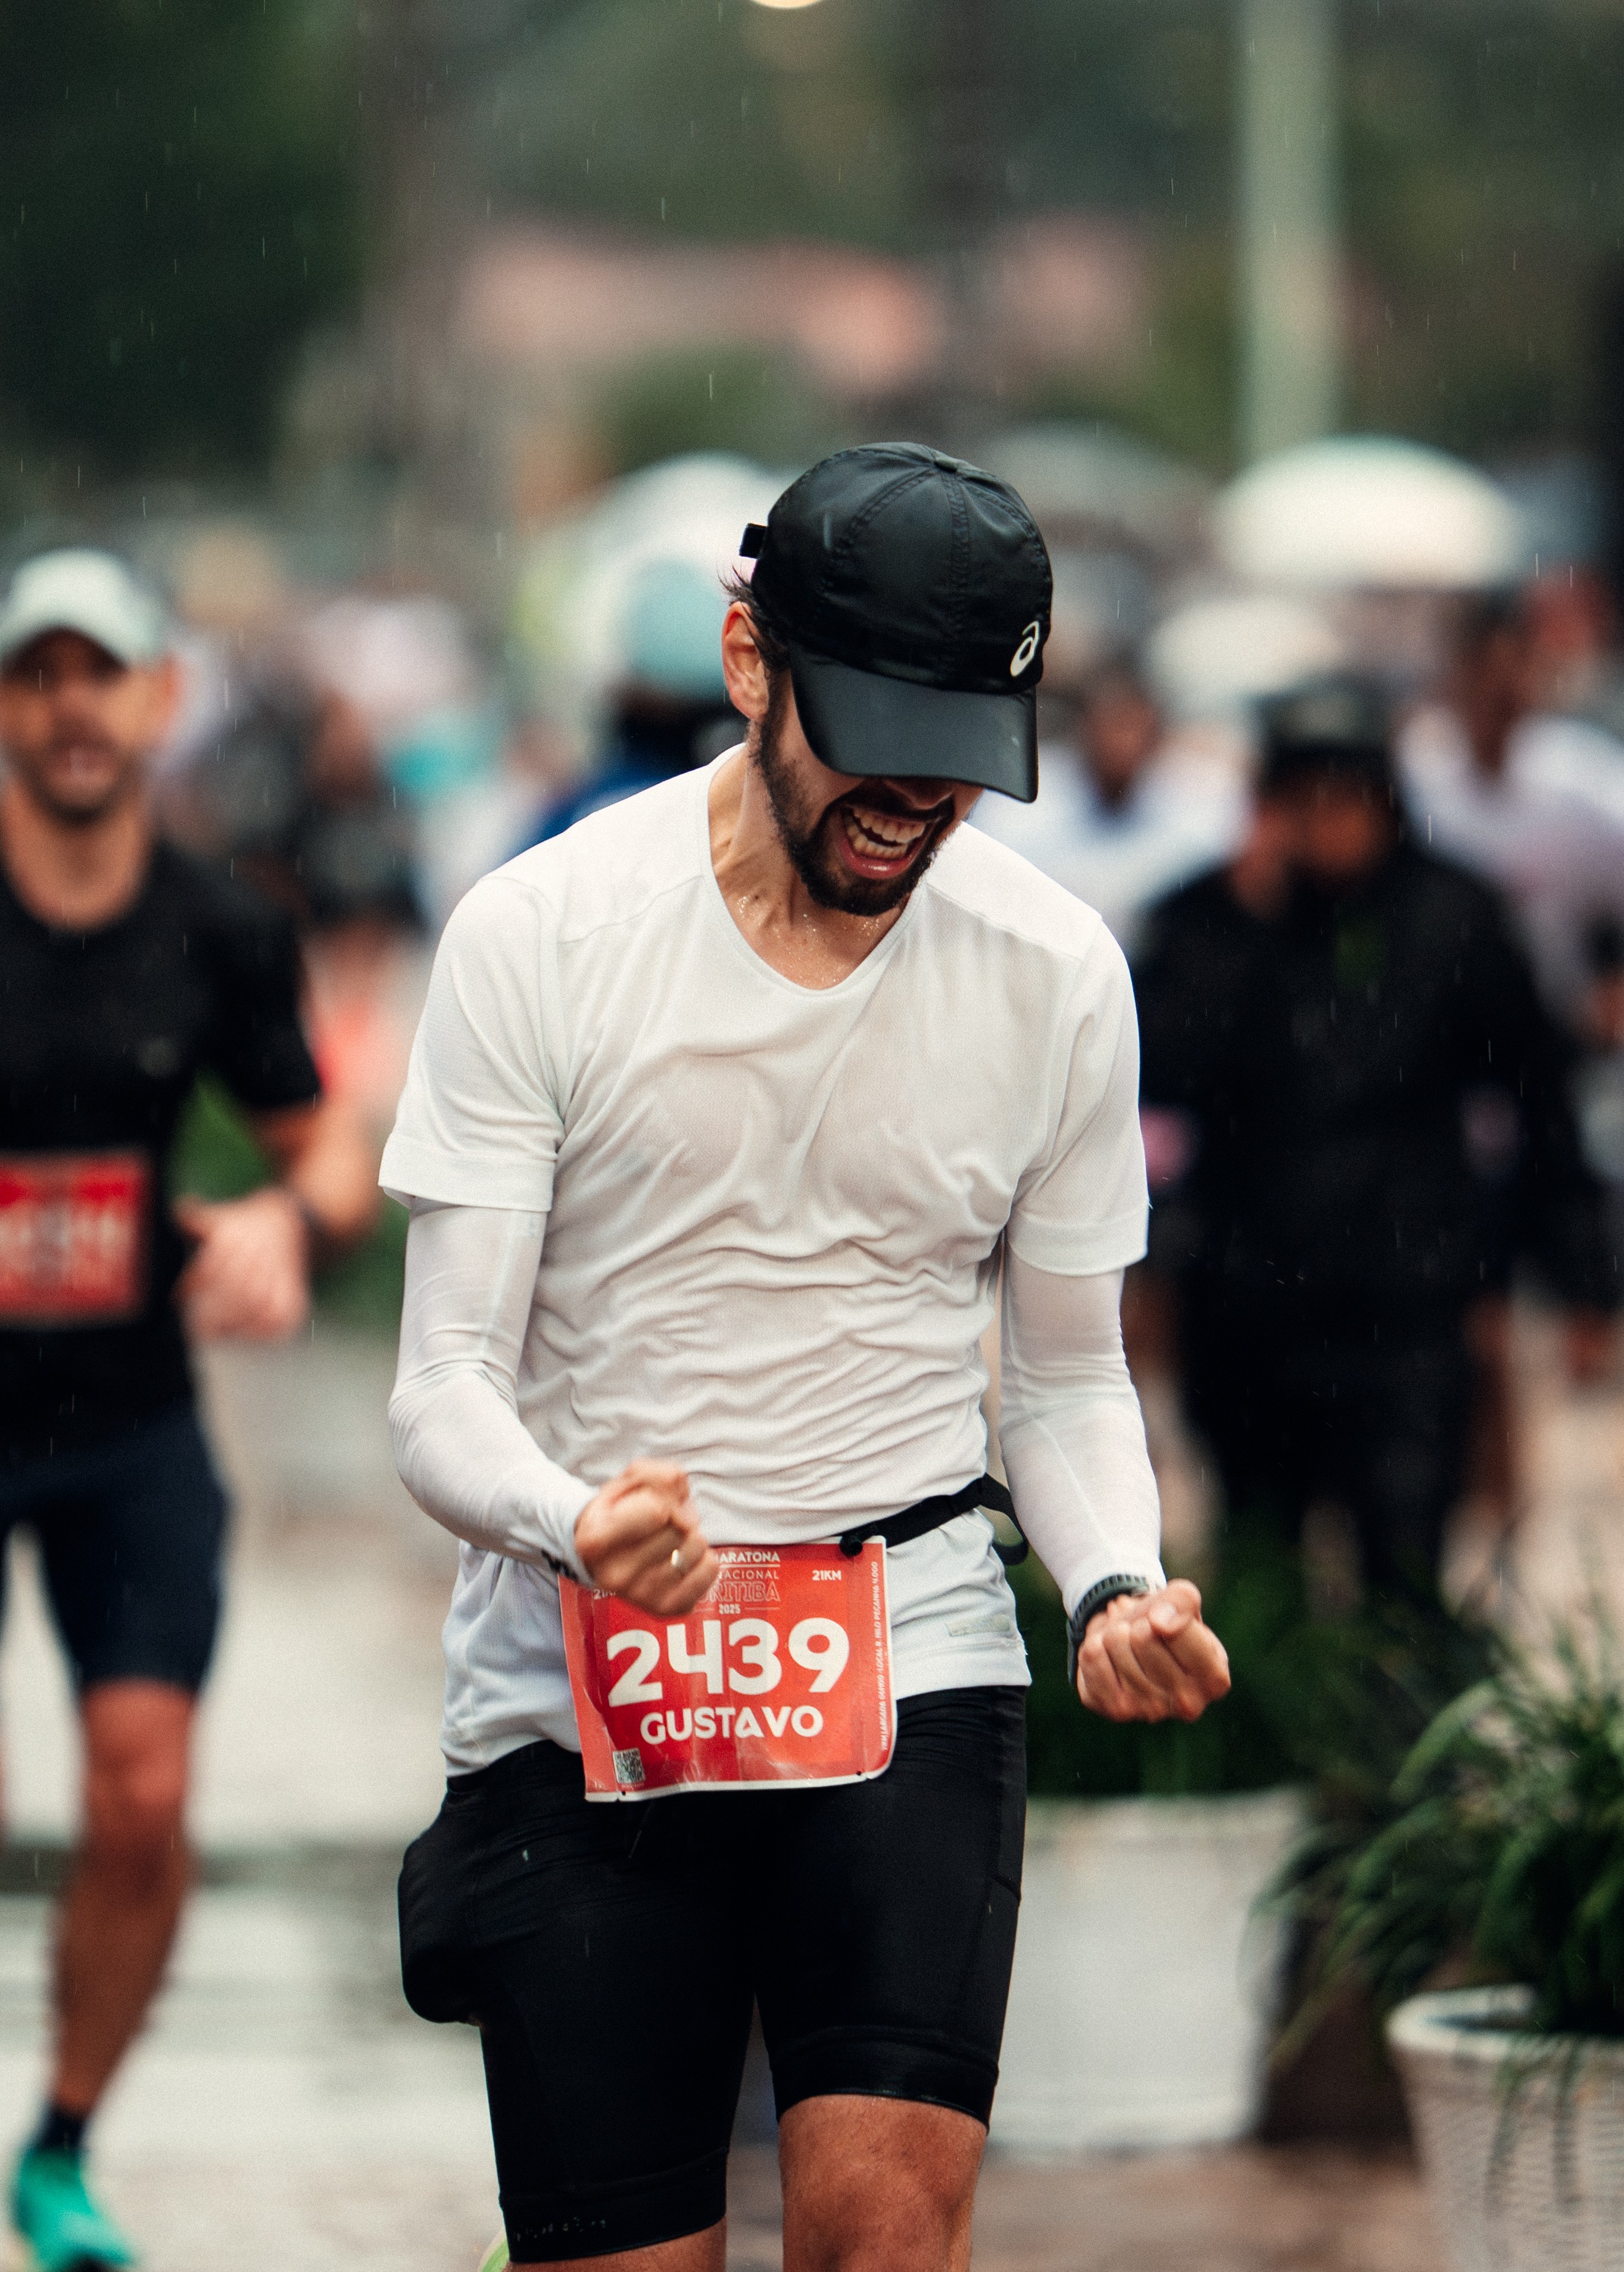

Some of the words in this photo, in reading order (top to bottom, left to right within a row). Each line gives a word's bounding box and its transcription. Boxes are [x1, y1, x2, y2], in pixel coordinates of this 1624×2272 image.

[812, 1569, 842, 1581] 21KM
[708, 1581, 780, 1602] RITIBA
[719, 1603, 741, 1614] 2025
[606, 1617, 850, 1708] 2439
[640, 1705, 824, 1746] GUSTAVO
